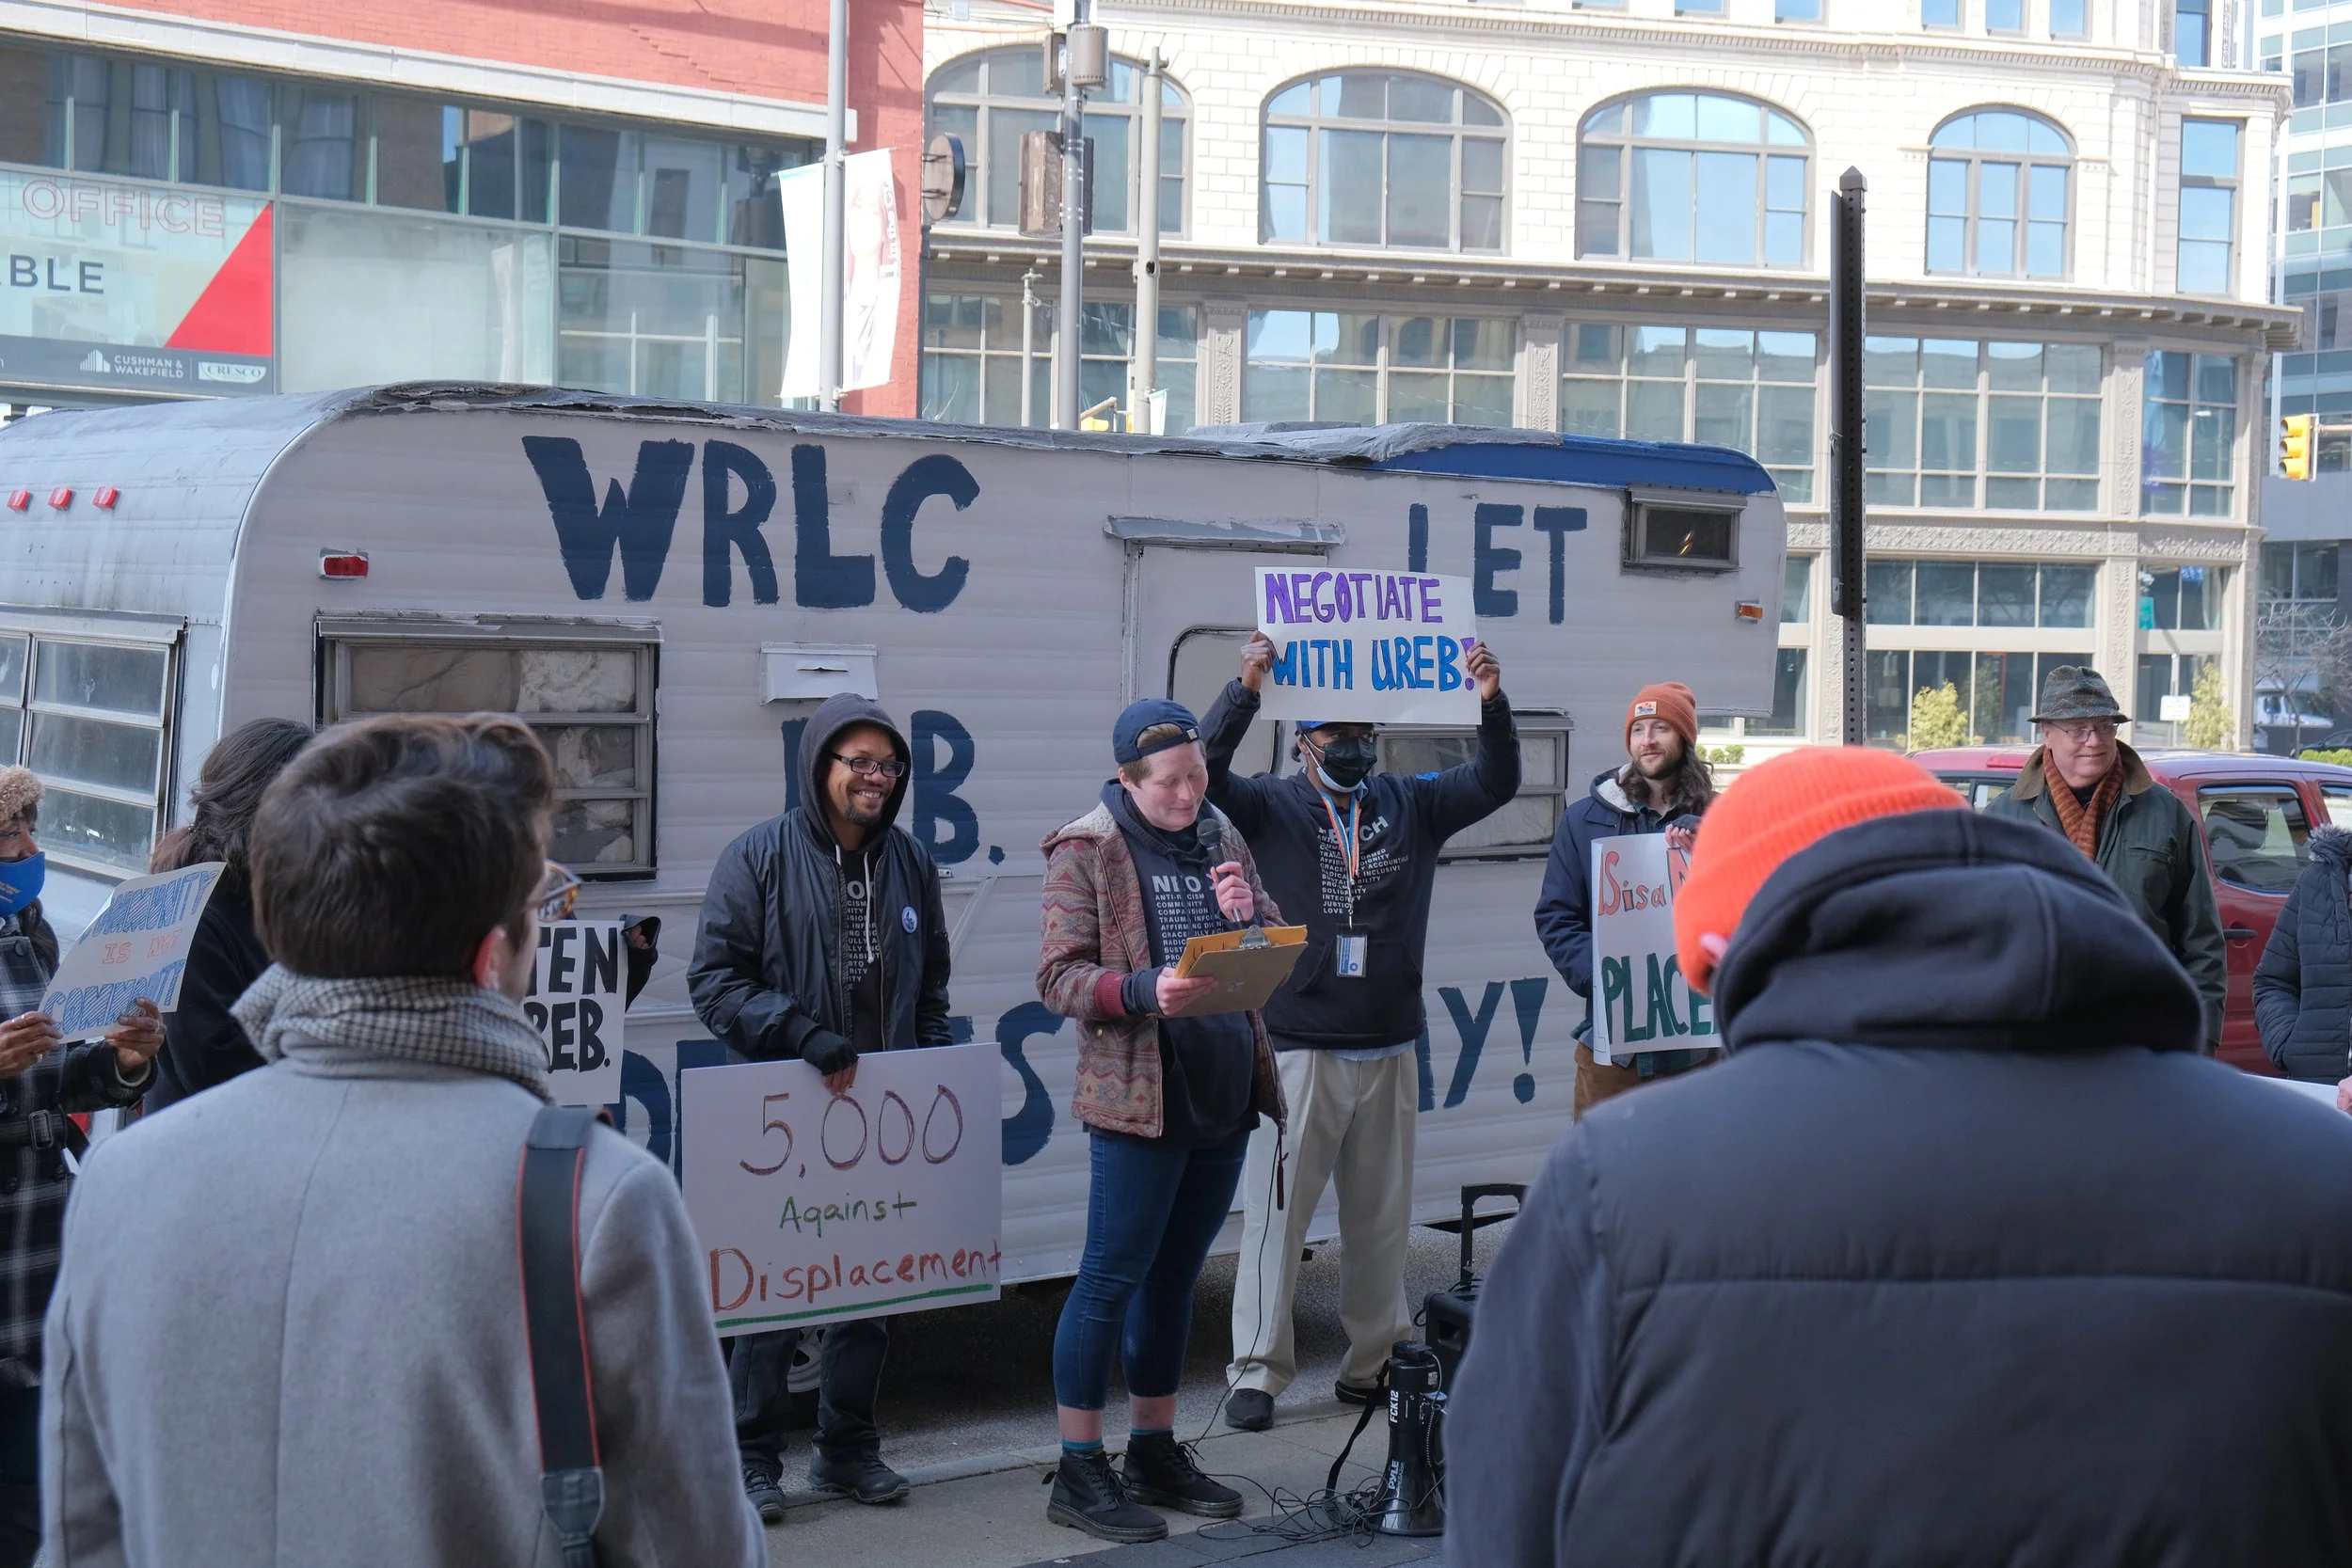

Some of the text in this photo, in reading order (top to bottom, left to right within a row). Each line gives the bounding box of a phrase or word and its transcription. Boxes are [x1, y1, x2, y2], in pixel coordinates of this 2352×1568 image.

[23, 180, 225, 238] OFFICE
[0, 253, 103, 294] BLE
[114, 354, 183, 369] CUSHMAN &
[114, 365, 184, 378] WAKEFIELD
[206, 364, 262, 377] CRESCO
[522, 436, 980, 613] WRLC
[1264, 571, 1443, 624] NEGOTIATE
[1270, 635, 1476, 691] WITH UREB!
[103, 928, 184, 965] IS NOT
[524, 926, 619, 997] TEN
[1601, 952, 1715, 1045] PLACE
[739, 1085, 963, 1179] 5,000
[779, 1191, 918, 1239] Against
[709, 1239, 1002, 1312] Displacement
[1390, 1389, 1400, 1423] FCK12
[1388, 1459, 1400, 1490] PYLE
